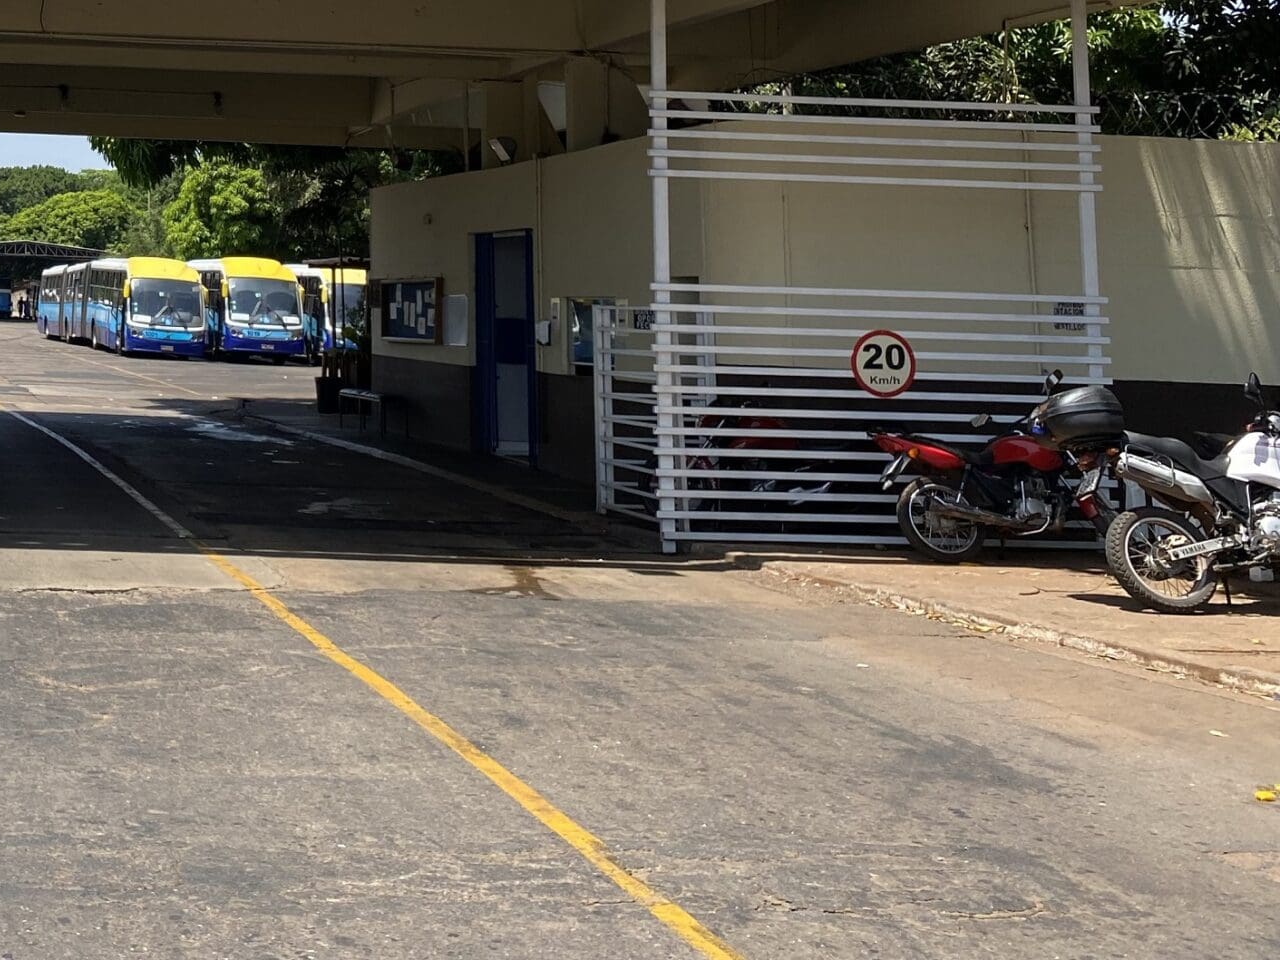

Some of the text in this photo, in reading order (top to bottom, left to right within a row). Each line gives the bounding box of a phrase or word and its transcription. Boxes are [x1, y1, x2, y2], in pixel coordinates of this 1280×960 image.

[862, 343, 906, 370] 20
[869, 375, 901, 385] Km/h
[1181, 543, 1207, 556] YAMAHA
